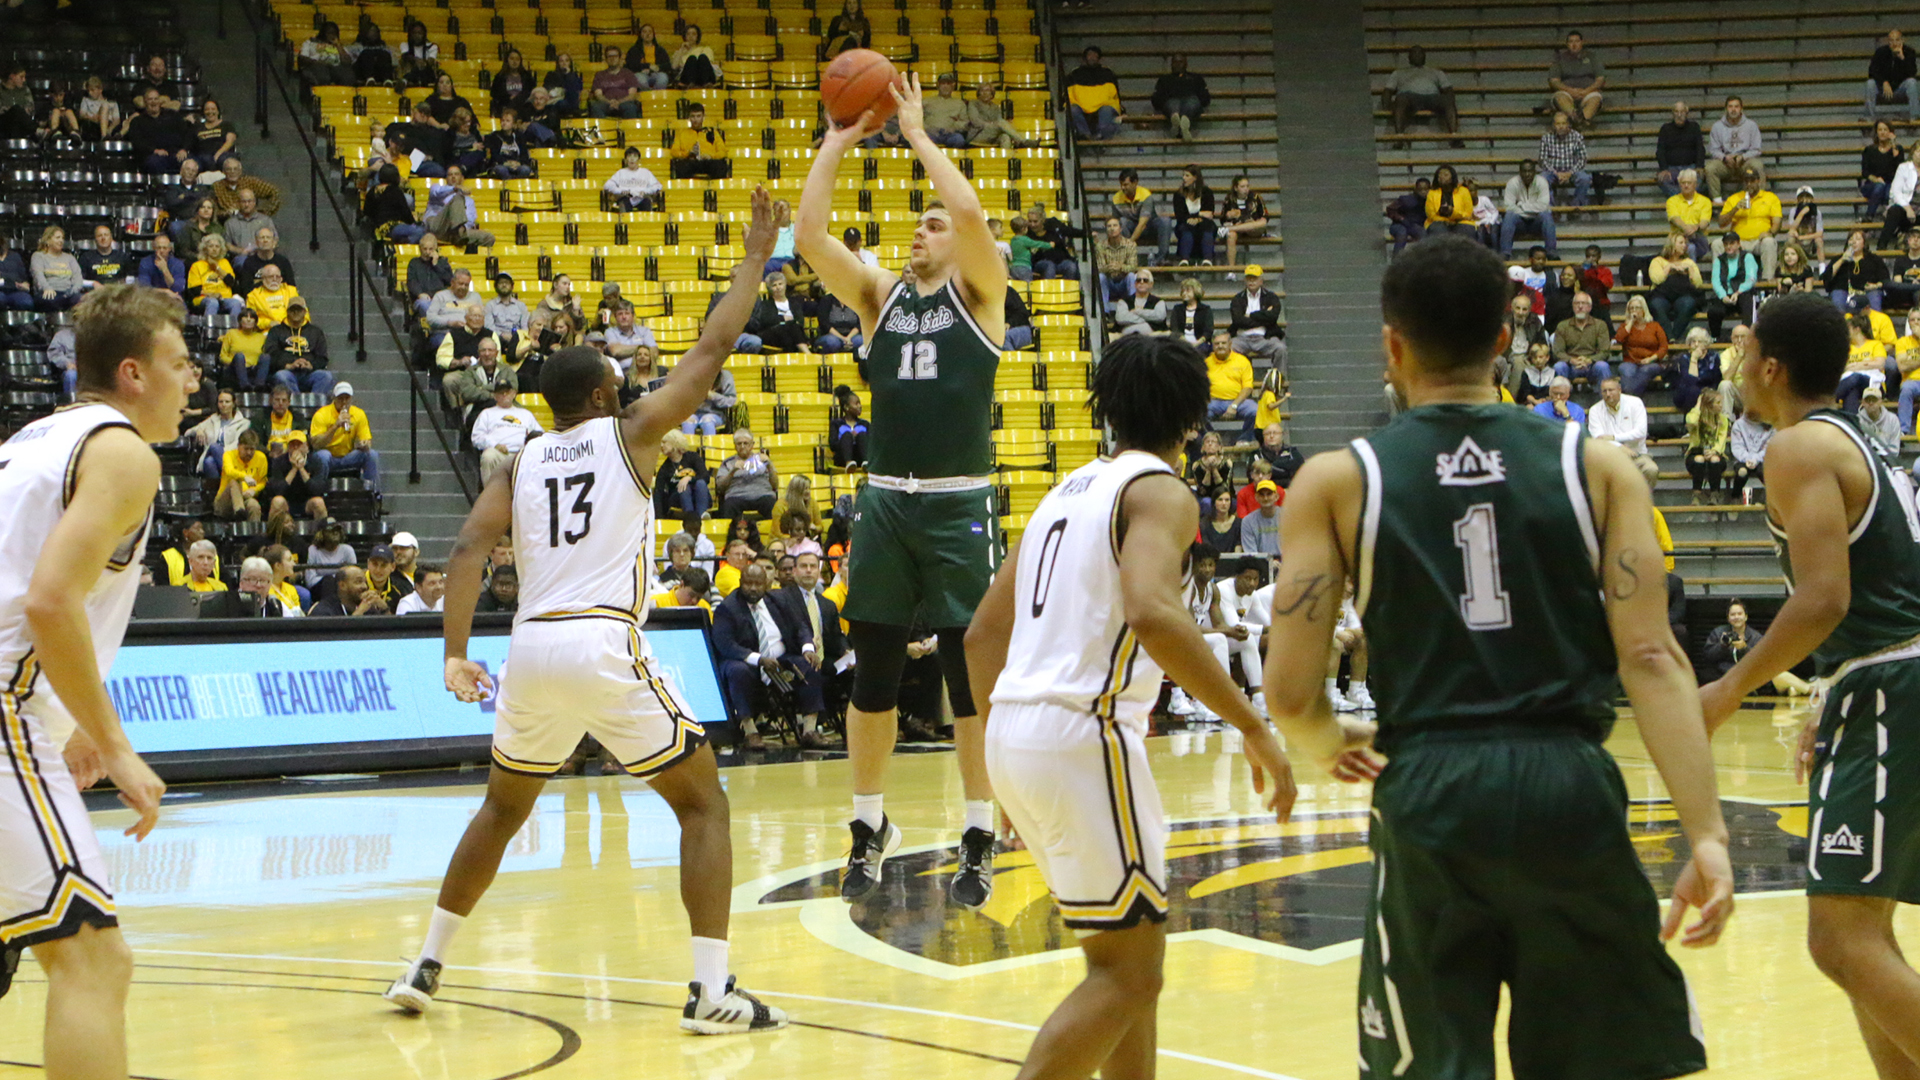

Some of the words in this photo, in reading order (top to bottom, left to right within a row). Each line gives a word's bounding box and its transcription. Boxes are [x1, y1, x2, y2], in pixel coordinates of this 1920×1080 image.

[897, 339, 938, 380] 12
[541, 439, 595, 464] JACDONMI
[1436, 447, 1506, 481] STATE
[544, 471, 596, 548] 13
[1031, 517, 1068, 619] 0
[1453, 502, 1513, 631] 1
[1612, 548, 1639, 600] S
[191, 672, 260, 720] BETTER
[255, 668, 397, 716] HEALTHCARE
[1822, 832, 1864, 851] STATE
